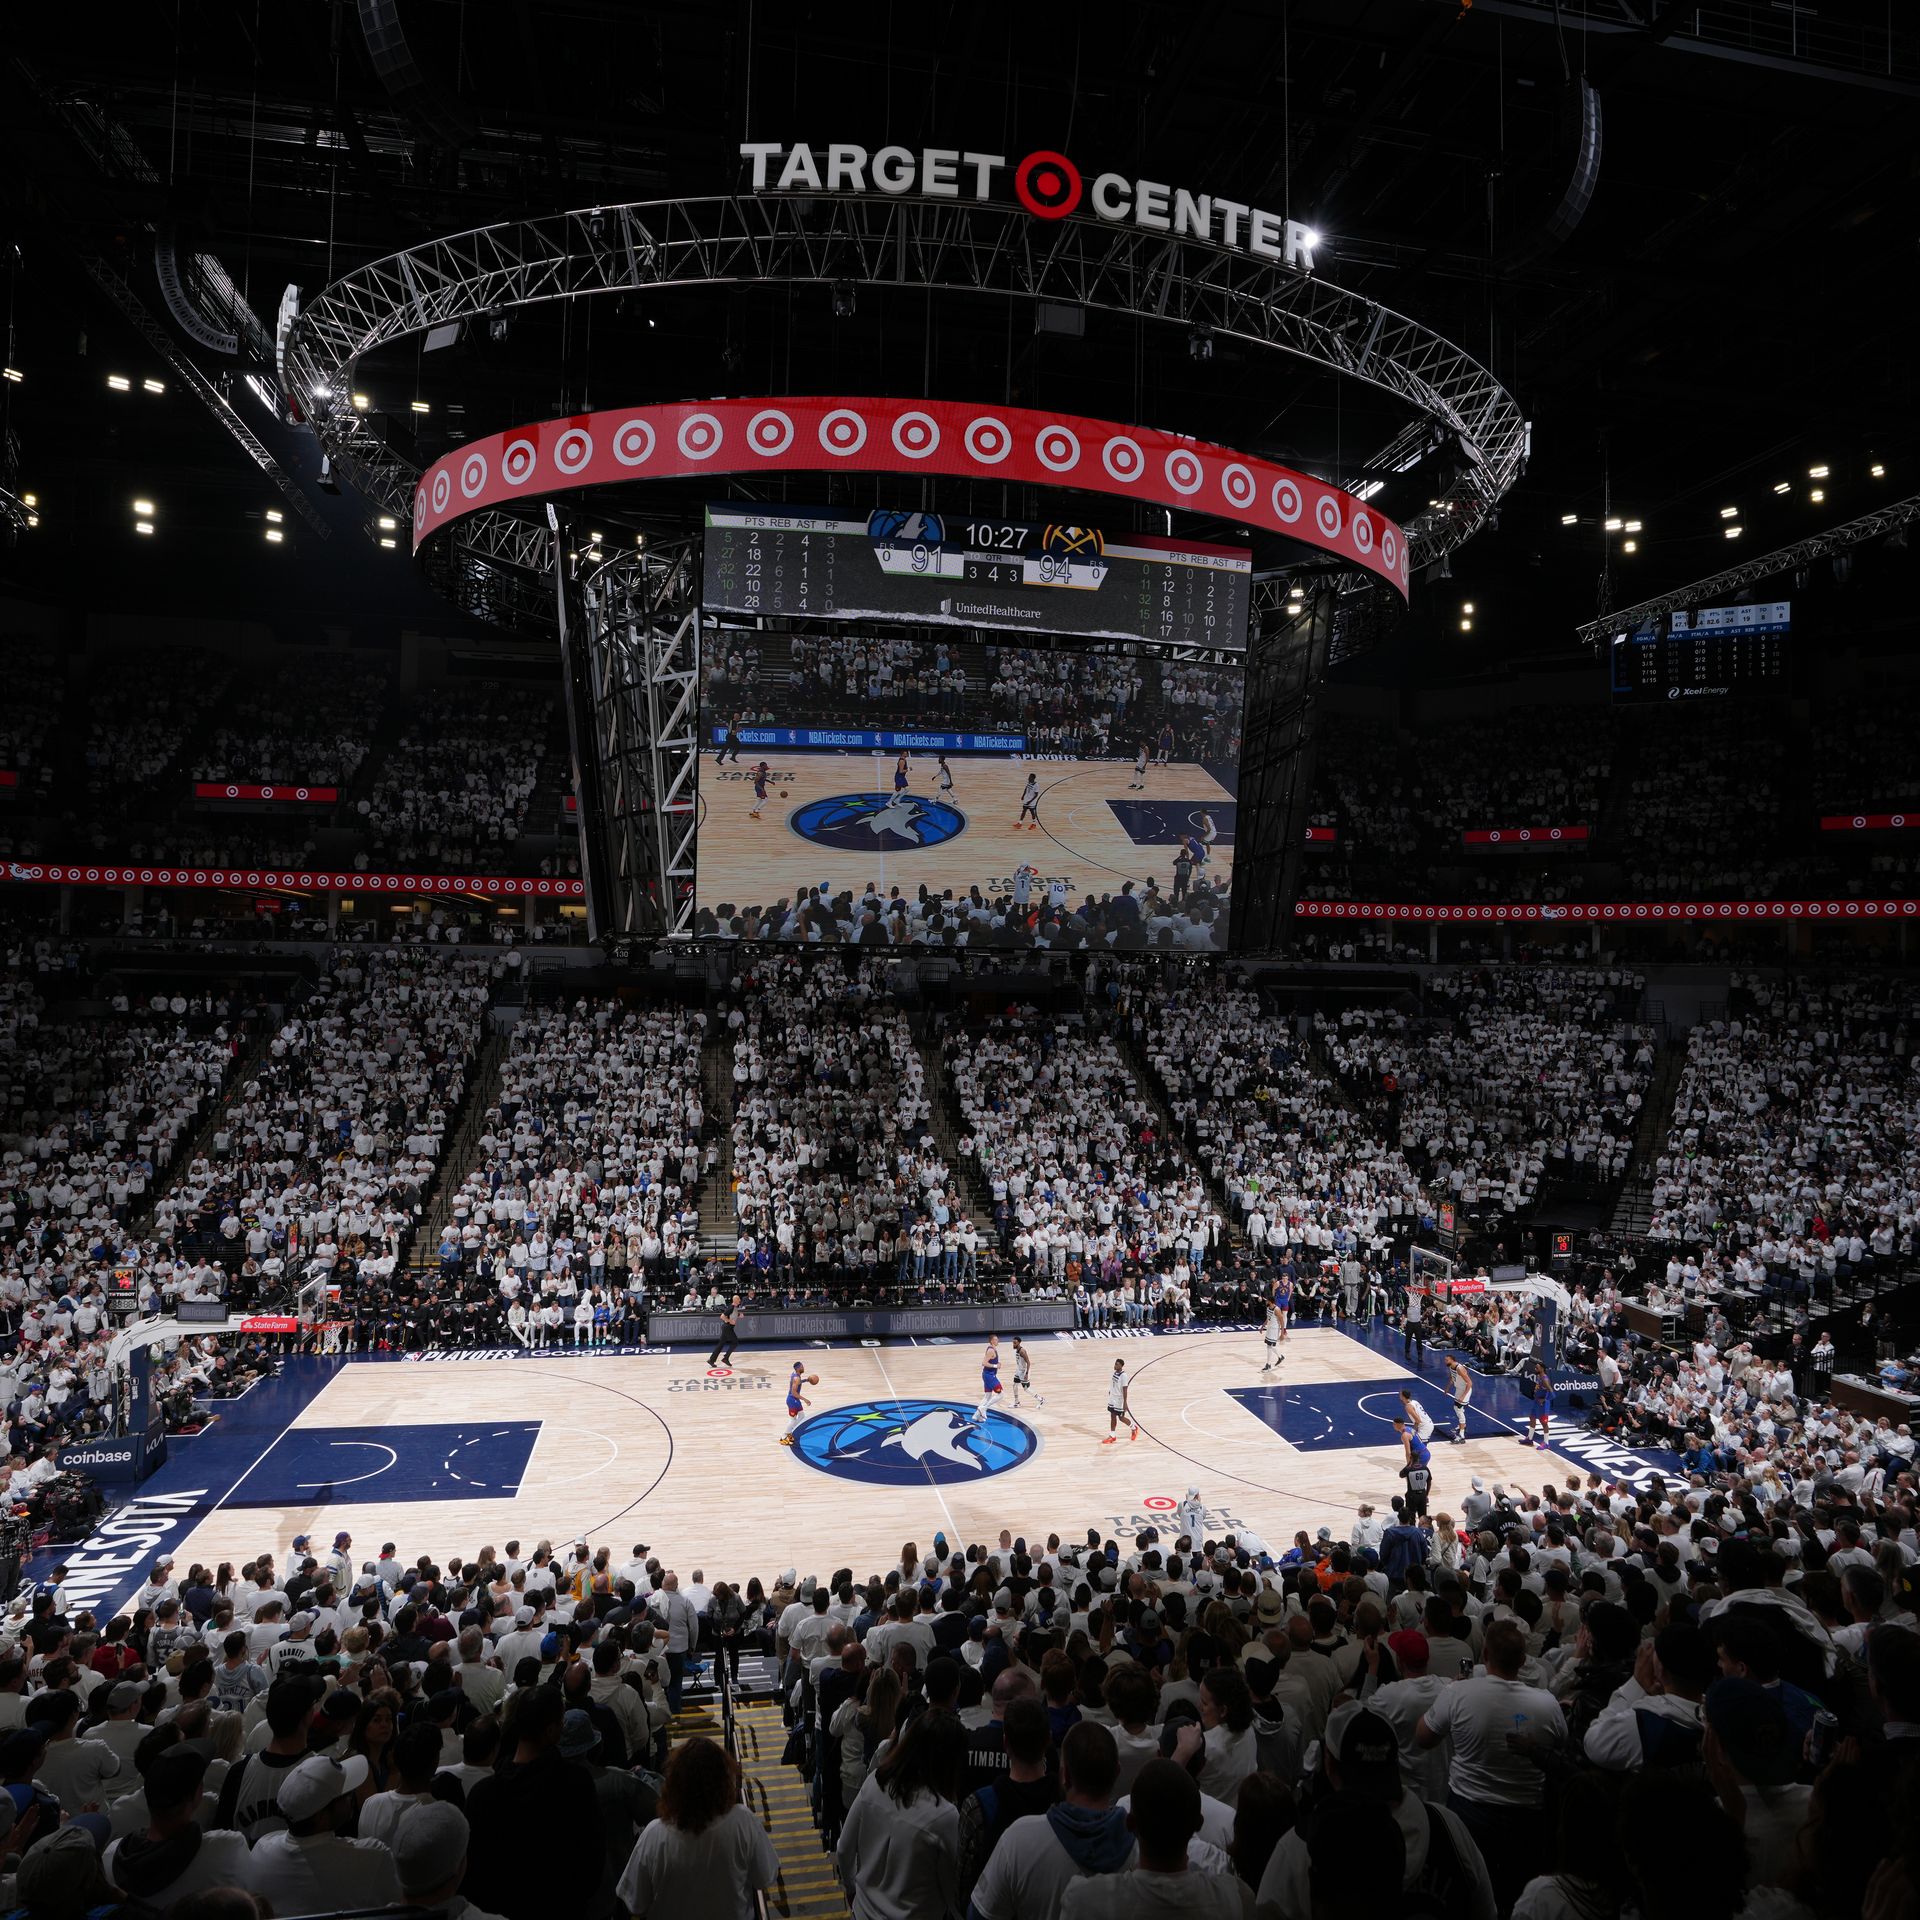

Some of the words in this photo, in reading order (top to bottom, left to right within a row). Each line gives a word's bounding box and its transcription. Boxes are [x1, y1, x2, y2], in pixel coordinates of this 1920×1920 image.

[740, 142, 1005, 200] TARGET
[1092, 172, 1314, 270] CENTER
[745, 517, 765, 526] PTS
[770, 519, 791, 527] REB
[797, 520, 816, 528] AST
[750, 532, 758, 544] 2
[776, 533, 784, 545] 2
[801, 535, 810, 546] 4
[827, 536, 835, 548] 3
[966, 523, 1028, 550] 10:27
[747, 549, 761, 560] 18
[776, 549, 784, 561] 7
[802, 552, 808, 563] 1
[826, 553, 834, 564] 3
[882, 550, 891, 562] 0
[912, 544, 941, 573] 91
[986, 554, 1002, 562] QTR
[1169, 553, 1187, 562] PTS
[1191, 555, 1208, 564] REB
[1213, 558, 1229, 567] AST
[1236, 561, 1246, 569] PF
[746, 564, 761, 576] 22
[775, 566, 783, 577] 6
[802, 567, 808, 578] 1
[827, 569, 833, 580] 1
[969, 566, 977, 579] 3
[988, 566, 999, 582] 4
[1009, 569, 1018, 582] 3
[1039, 554, 1072, 584] 94
[1092, 567, 1100, 579] 0
[1165, 566, 1172, 577] 3
[1187, 569, 1193, 580] 0
[1209, 571, 1214, 582] 1
[1229, 575, 1235, 585] 0
[721, 579, 734, 590] 10
[746, 580, 761, 592] 10
[774, 581, 782, 593] 2
[800, 582, 808, 594] 5
[826, 584, 833, 595] 3
[1162, 581, 1175, 593] 12
[1186, 583, 1193, 594] 3
[1207, 586, 1214, 597] 2
[1228, 589, 1235, 600] 2
[744, 596, 760, 607] 28
[774, 597, 781, 608] 5
[799, 598, 807, 610] 4
[825, 600, 833, 611] 0
[956, 602, 1041, 619] UnitedHealthcare
[1163, 596, 1170, 607] 8
[1207, 601, 1214, 612] 2
[1228, 603, 1234, 614] 2
[1161, 611, 1173, 622] 16
[1183, 613, 1194, 624] 10
[1204, 615, 1215, 627] 10
[1226, 618, 1232, 629] 4
[1160, 626, 1172, 637] 17
[1184, 628, 1190, 638] 7
[1206, 630, 1211, 640] 1
[1226, 633, 1232, 643] 2
[1683, 687, 1702, 696] Xcel
[1703, 686, 1729, 696] Energy
[808, 732, 863, 745] NBATickets.com
[894, 734, 945, 747] NBATickets.com
[974, 736, 1022, 749] NBATickets.com
[774, 1317, 846, 1334] NBATickets.com
[890, 1313, 960, 1330] NBATickets.com
[1002, 1309, 1070, 1327] NBATickets.com
[656, 1320, 722, 1337] NBATickets.co
[1072, 1327, 1154, 1339] PLAYOFFS
[1162, 1325, 1236, 1334] Google
[423, 1349, 520, 1361] PLAYOFFS
[531, 1348, 615, 1358] Google
[620, 1346, 672, 1355] Pixel
[667, 1383, 772, 1392] CENTER
[668, 1376, 773, 1385] TARGET
[1553, 1380, 1599, 1392] coinbase
[62, 1450, 132, 1466] coinbase
[1511, 1414, 1690, 1493] MINNESO
[1191, 1515, 1195, 1527] 1
